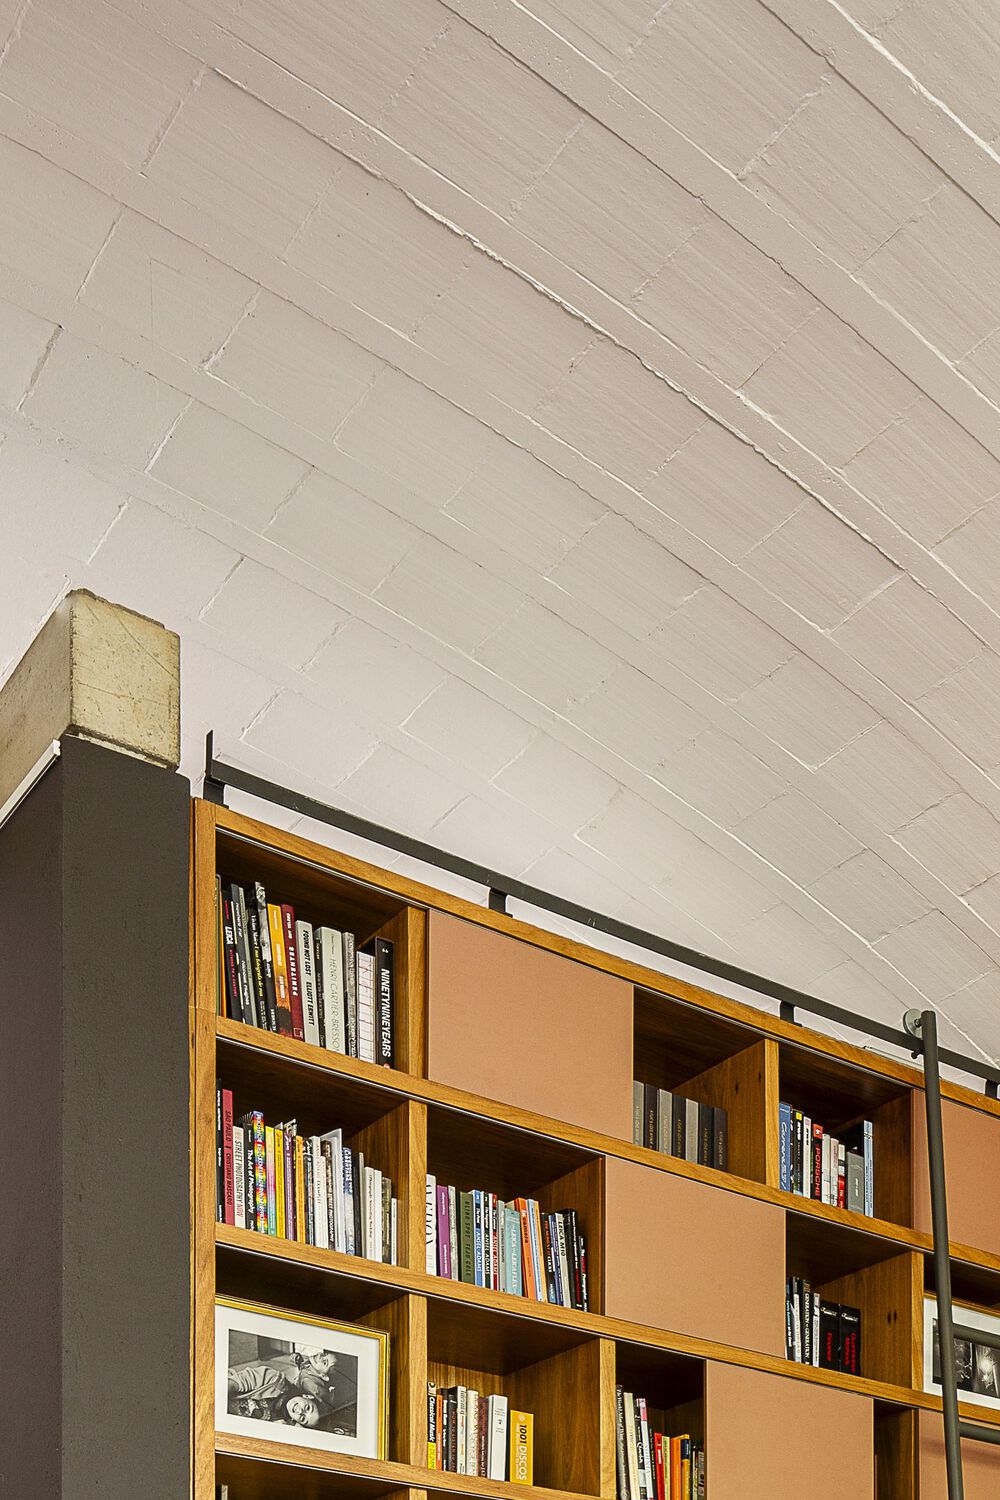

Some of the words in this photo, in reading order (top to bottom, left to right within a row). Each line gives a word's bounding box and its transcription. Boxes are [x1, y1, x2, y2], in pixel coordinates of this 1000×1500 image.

[225, 926, 233, 944] LEICA
[329, 959, 337, 982] HENRI
[381, 968, 390, 1057] NINETYNINEYEARS
[235, 1163, 243, 1202] PHOTOGRAPHY
[236, 1203, 244, 1217] NOW
